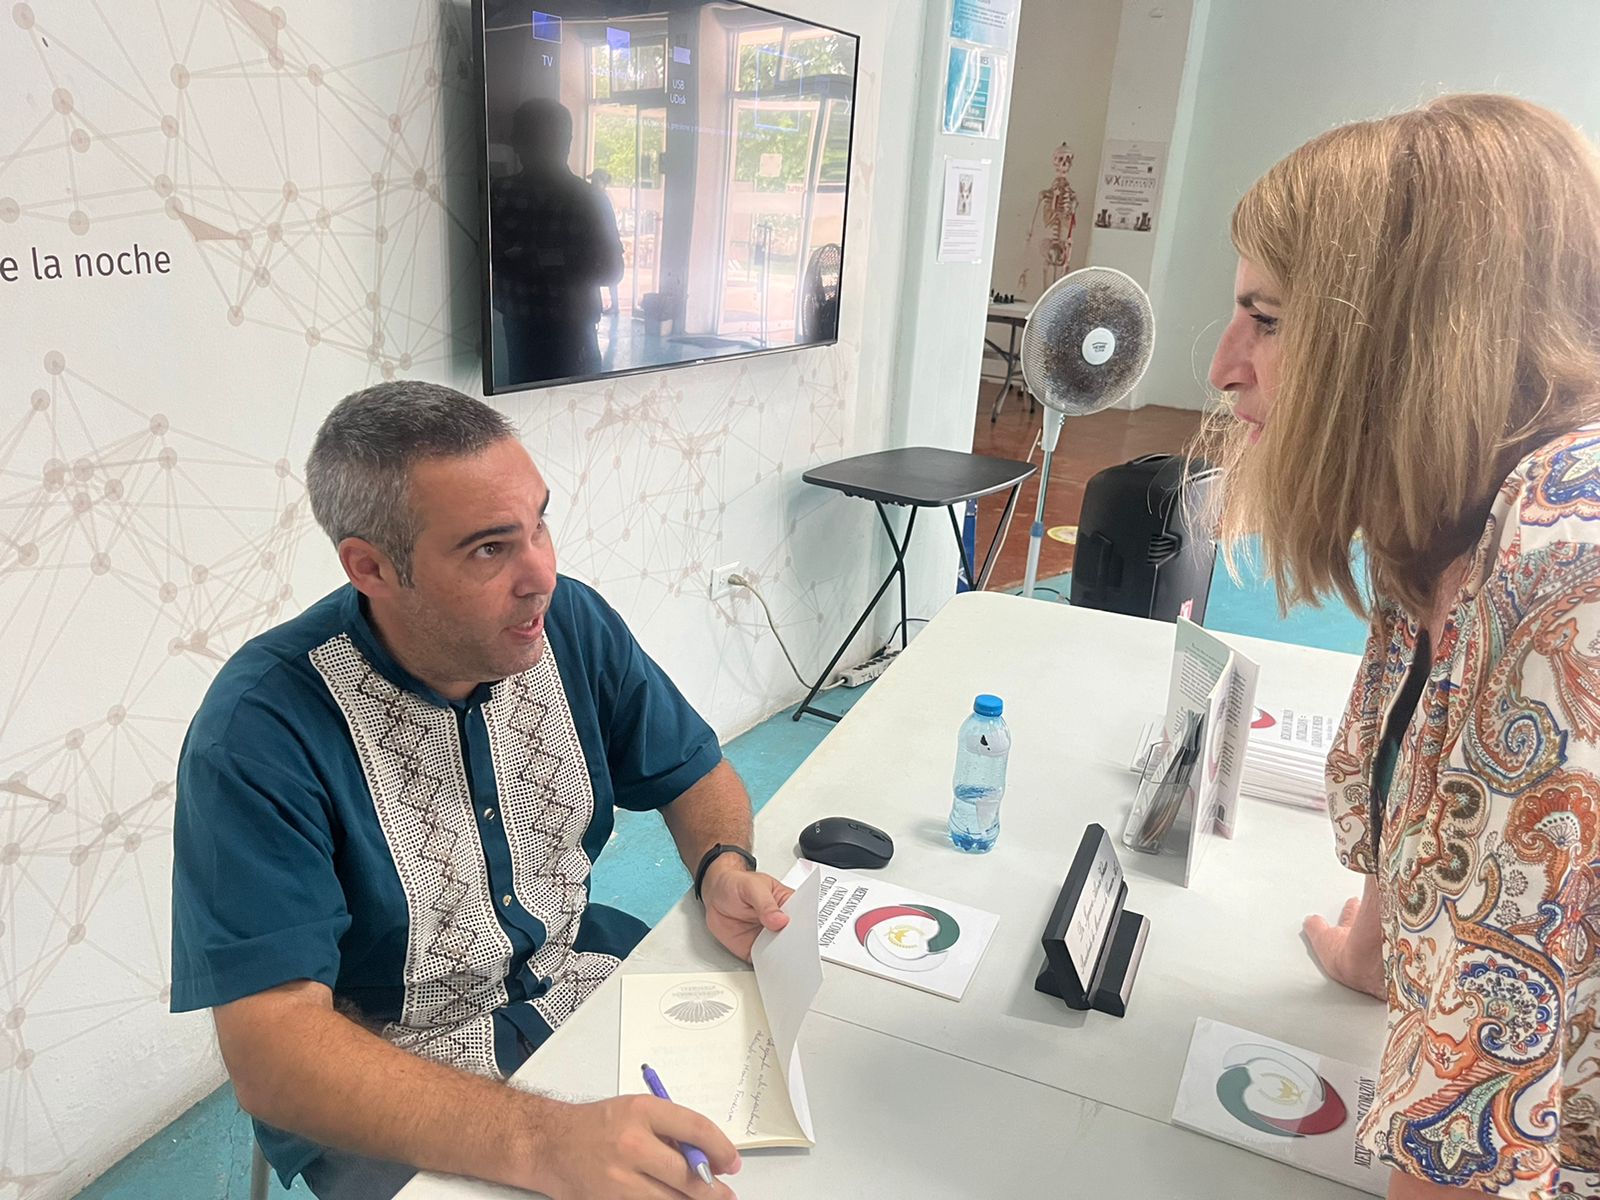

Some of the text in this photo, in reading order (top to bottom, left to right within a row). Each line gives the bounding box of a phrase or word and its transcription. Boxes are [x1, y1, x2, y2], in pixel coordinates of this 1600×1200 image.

[542, 55, 553, 67] TV
[672, 79, 685, 90] USB
[31, 247, 62, 280] la
[75, 243, 171, 278] noche
[819, 885, 869, 948] MEXICANOS DE CORAZÓN
[1354, 1076, 1375, 1111] CORAZÓN
[1354, 1139, 1374, 1169] MEXIC
